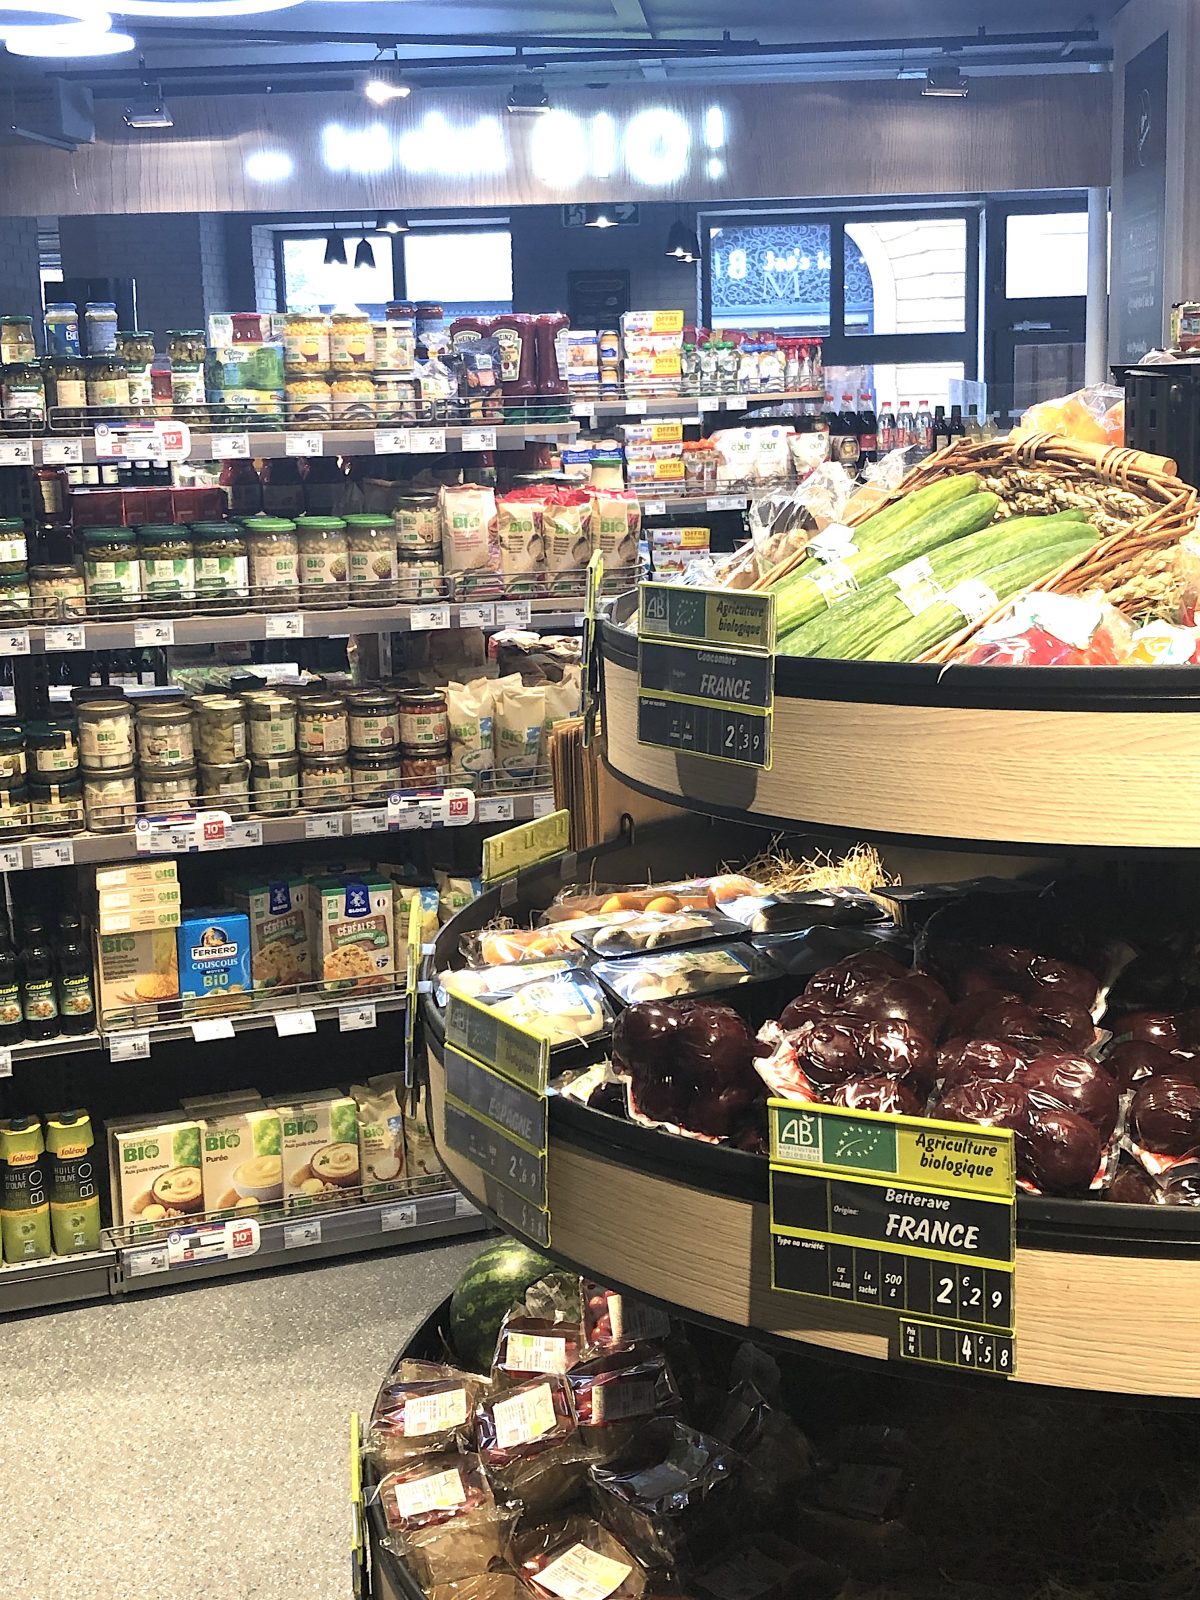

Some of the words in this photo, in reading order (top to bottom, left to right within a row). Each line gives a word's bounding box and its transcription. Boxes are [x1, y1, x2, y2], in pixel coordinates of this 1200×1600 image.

[509, 520, 533, 533] BIO
[600, 521, 626, 533] BIO
[276, 559, 294, 571] BIO
[306, 558, 325, 568] BIO
[351, 556, 368, 566] BIO
[716, 600, 765, 618] Agriculture
[718, 619, 762, 637] biologique
[699, 674, 752, 700] FRANCE
[97, 732, 117, 742] BIO
[455, 726, 478, 737] BIO
[263, 915, 297, 935] CÉRÉALES
[337, 920, 376, 937] CÉRÉALES
[101, 938, 136, 953] BIO
[193, 946, 236, 957] FERRERO
[488, 1097, 533, 1140] ESPAGNE
[283, 1119, 318, 1137] BIO
[364, 1127, 385, 1138] BIO
[205, 1134, 241, 1151] BIO
[307, 1138, 328, 1146] chiches
[915, 1133, 998, 1158] Agriculture
[123, 1144, 160, 1163] BIO
[206, 1154, 229, 1163] Purée
[54, 1166, 76, 1174] HUILE
[148, 1163, 170, 1171] chiches
[920, 1156, 994, 1178] biologique
[78, 1162, 94, 1198] BIO
[28, 1169, 45, 1205] BIO
[885, 1188, 950, 1212] Betterave
[885, 1213, 980, 1249] FRANCE
[777, 1235, 792, 1246] Type
[863, 1271, 872, 1280] Le
[884, 1273, 903, 1286] 500
[858, 1285, 878, 1295] sachet
